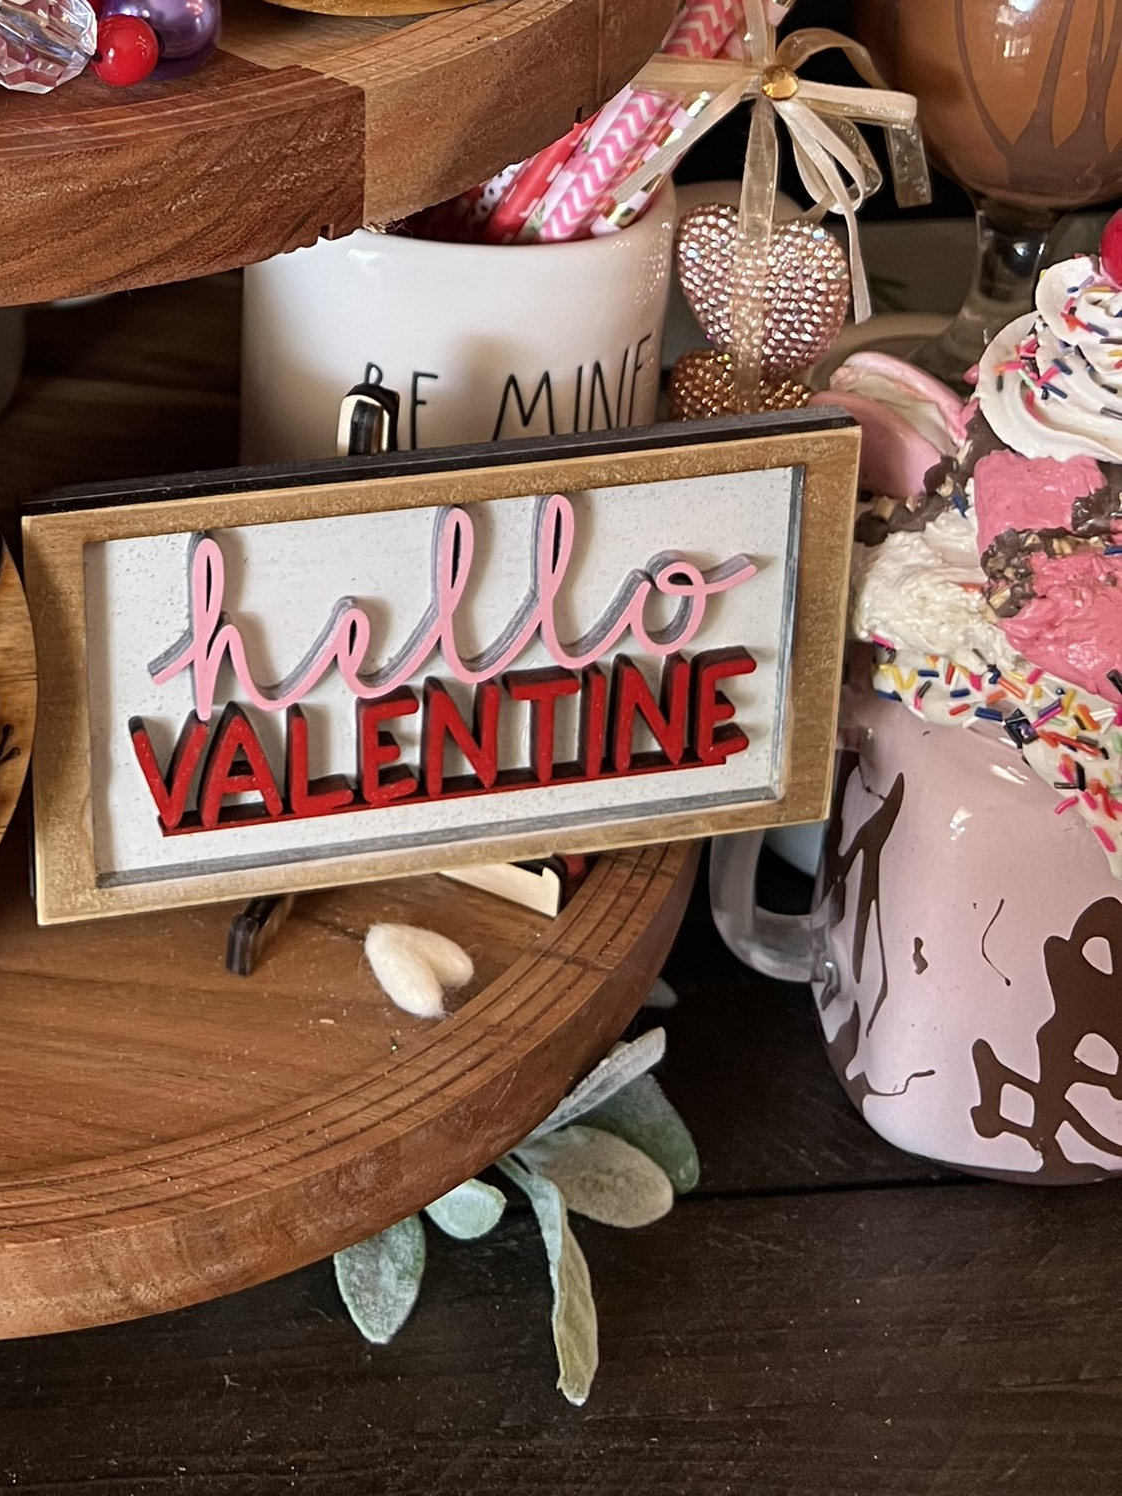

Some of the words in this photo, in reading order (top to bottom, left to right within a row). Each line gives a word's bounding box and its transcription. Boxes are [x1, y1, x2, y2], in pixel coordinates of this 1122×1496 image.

[491, 332, 653, 442] MINE
[147, 494, 758, 721] hello
[128, 646, 757, 836] VALENTINE
